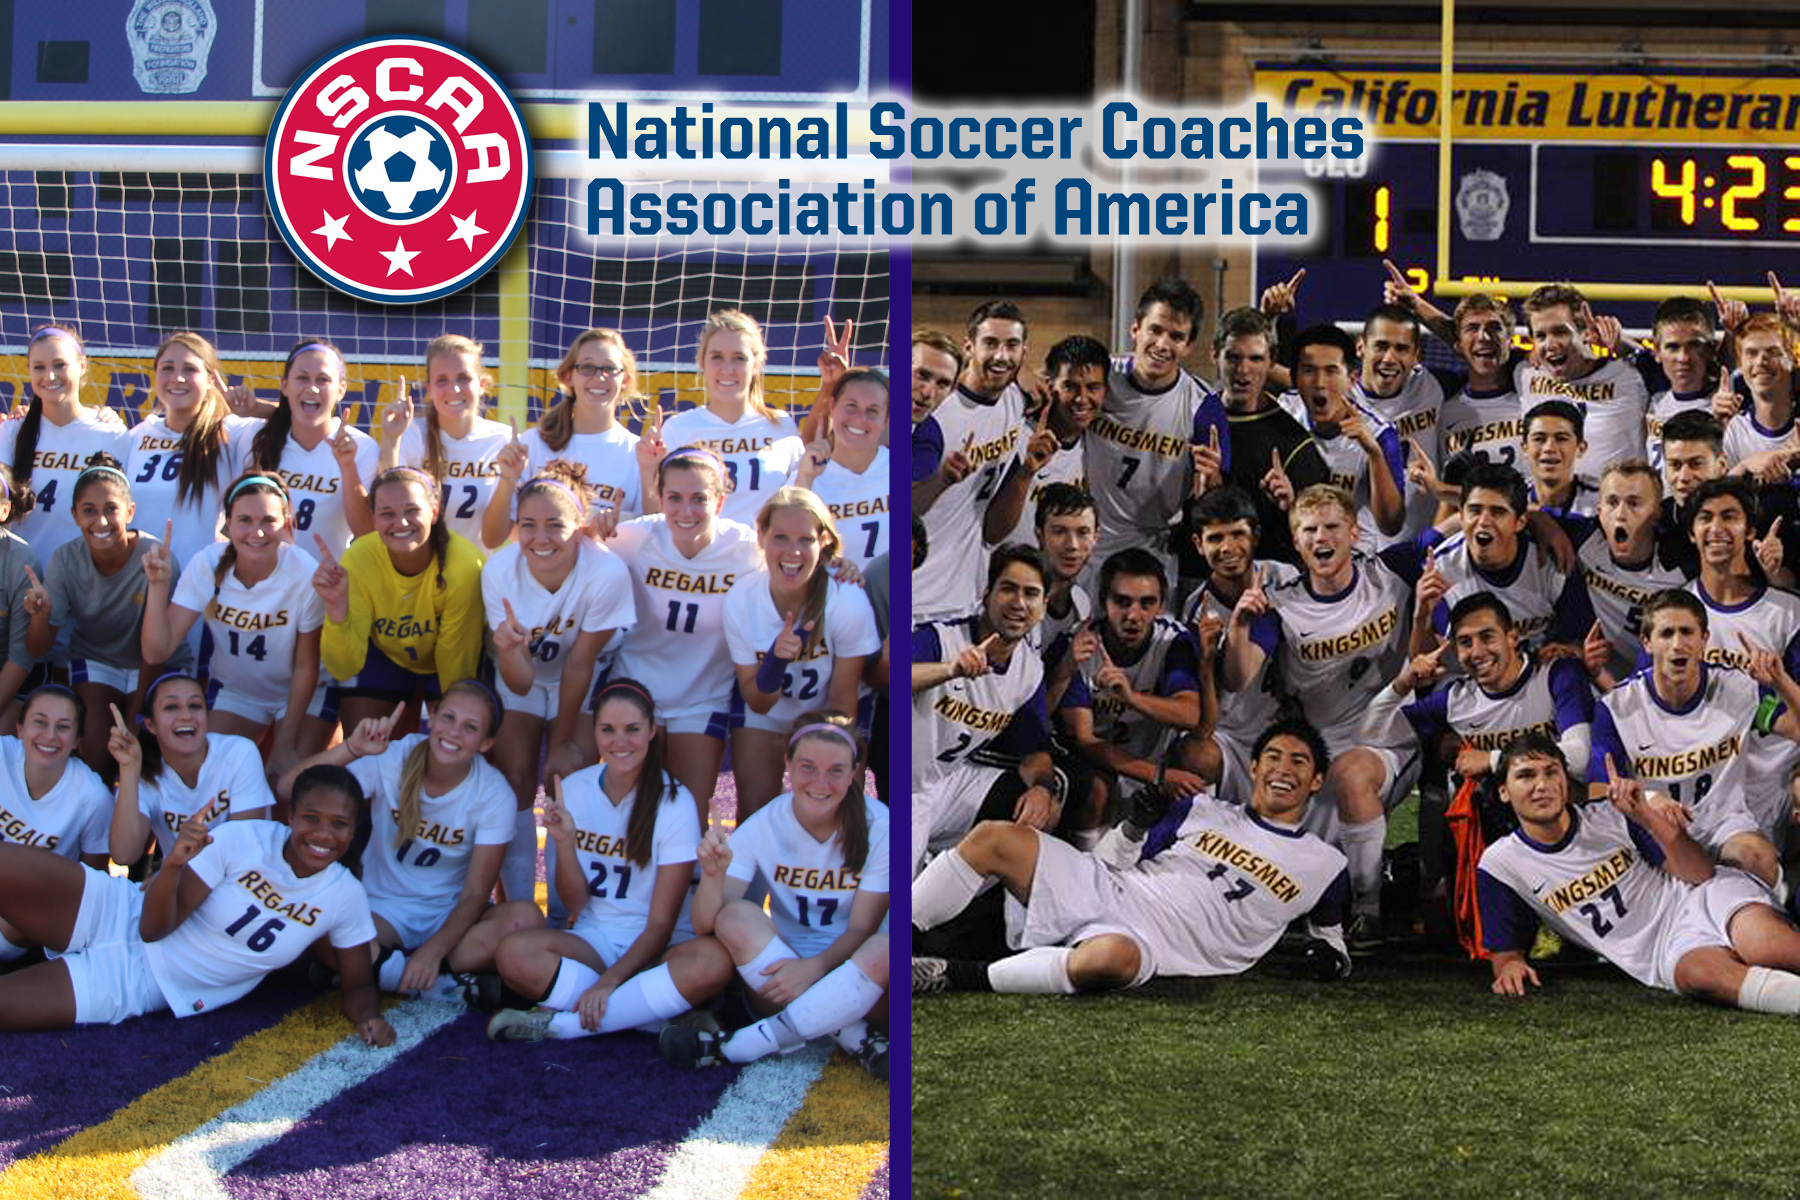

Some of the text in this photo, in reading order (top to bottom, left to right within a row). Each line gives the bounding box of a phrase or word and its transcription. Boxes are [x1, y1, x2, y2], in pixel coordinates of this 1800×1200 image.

[1374, 186, 1390, 253] 1
[138, 434, 184, 451] REGA
[700, 436, 774, 454] EGALS
[32, 450, 93, 472] EGALS
[136, 453, 183, 483] 36
[1115, 456, 1141, 490] 7
[36, 479, 58, 513] 4
[278, 468, 340, 495] EGALS
[861, 520, 879, 558] 7
[644, 566, 736, 595] REGALS
[212, 602, 290, 632] REGALS
[374, 614, 442, 639] REGAL
[666, 600, 699, 634] 11
[229, 630, 268, 662] 14
[1634, 735, 1742, 779] KINGSMEN
[0, 804, 61, 850] EGALS
[575, 828, 629, 859] REGA
[589, 861, 632, 899] 27
[773, 863, 863, 892] REGALS
[1193, 829, 1302, 905] KINGSMEN
[236, 869, 323, 929] REGALS
[795, 894, 839, 928] 17
[1579, 883, 1628, 939] 27
[224, 904, 287, 953] 16
